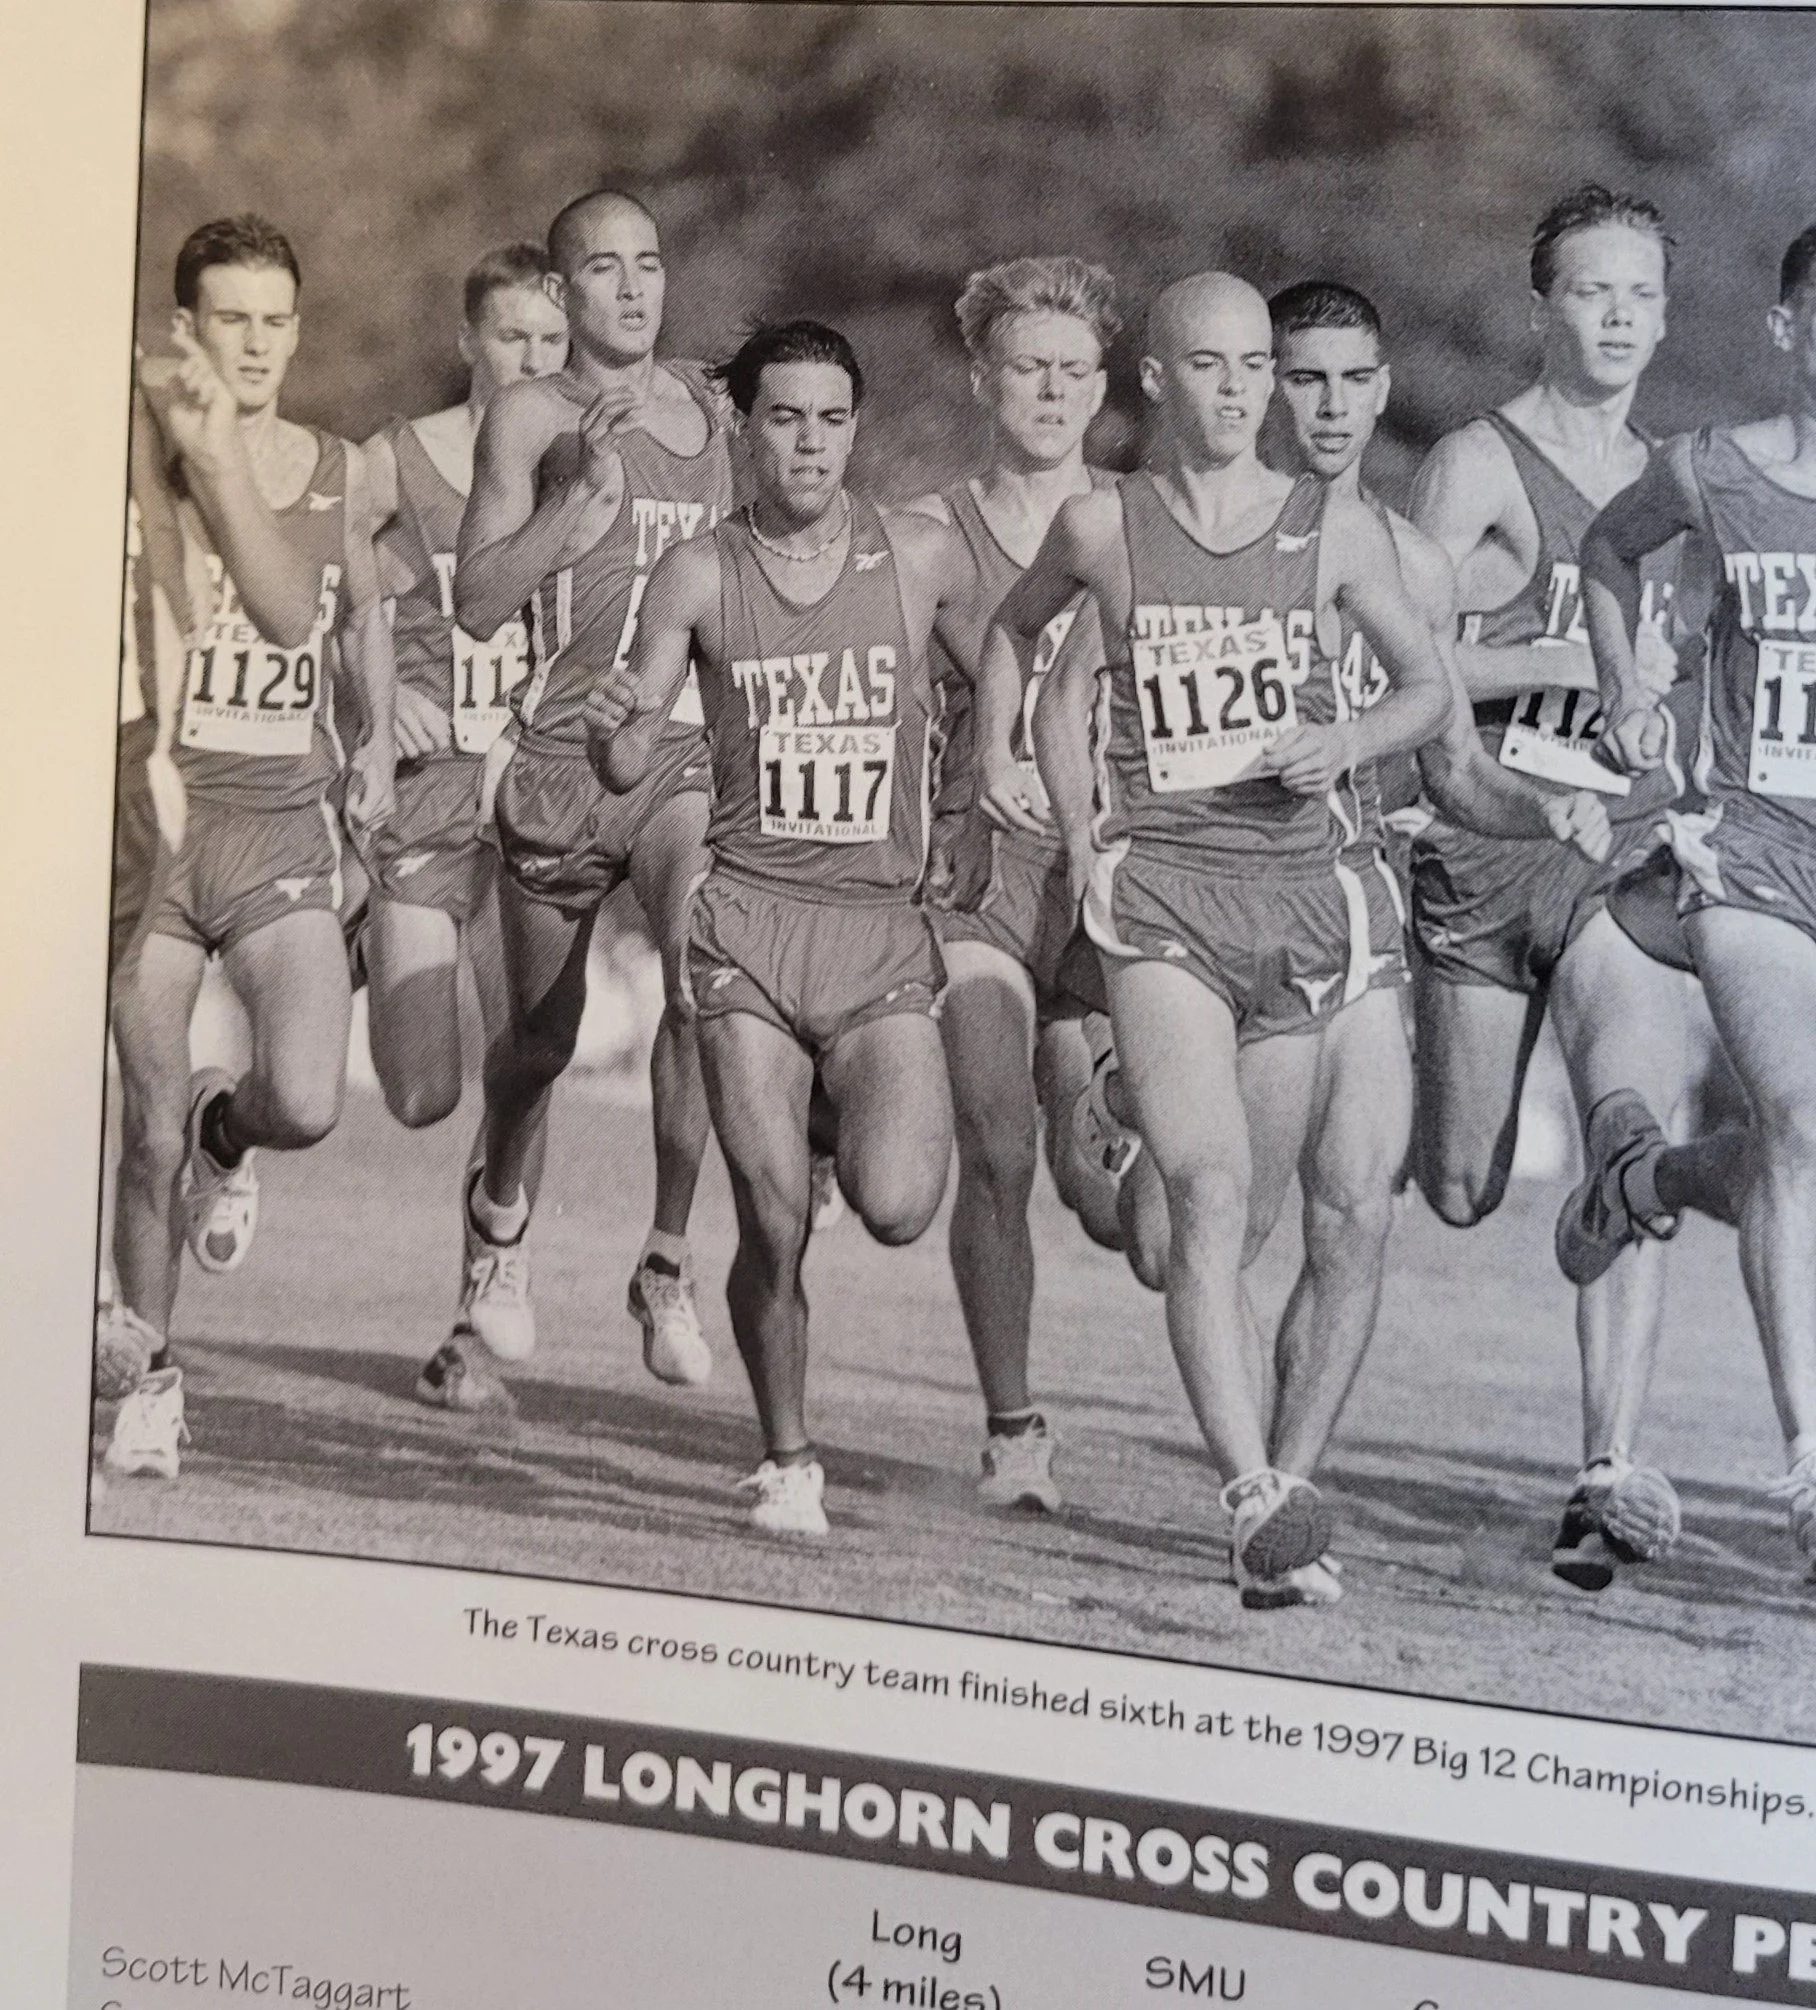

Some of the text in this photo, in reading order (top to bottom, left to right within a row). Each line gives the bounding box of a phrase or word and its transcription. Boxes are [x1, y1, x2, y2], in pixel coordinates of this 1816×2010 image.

[193, 646, 315, 710] 1129
[1150, 627, 1273, 667] TEXAS
[731, 645, 897, 729] TEXAS
[1143, 658, 1287, 739] 1126
[772, 731, 882, 755] TEXAS
[765, 759, 888, 822] 1117
[771, 820, 876, 837] INVITATIONAL
[464, 1608, 1815, 1825] The Texas cross country team finished sixth at the 1997 Big 12 Championships.
[406, 1722, 566, 1792] 1997
[583, 1744, 1011, 1858] LONGHORN
[1032, 1811, 1270, 1899] CROSS
[1292, 1851, 1712, 1965] COUNTRY
[872, 1908, 962, 1964] Long
[102, 1946, 411, 2010] Scott McTaggart
[828, 1959, 1001, 2010] (4 miles)
[1145, 1955, 1246, 2001] SMU
